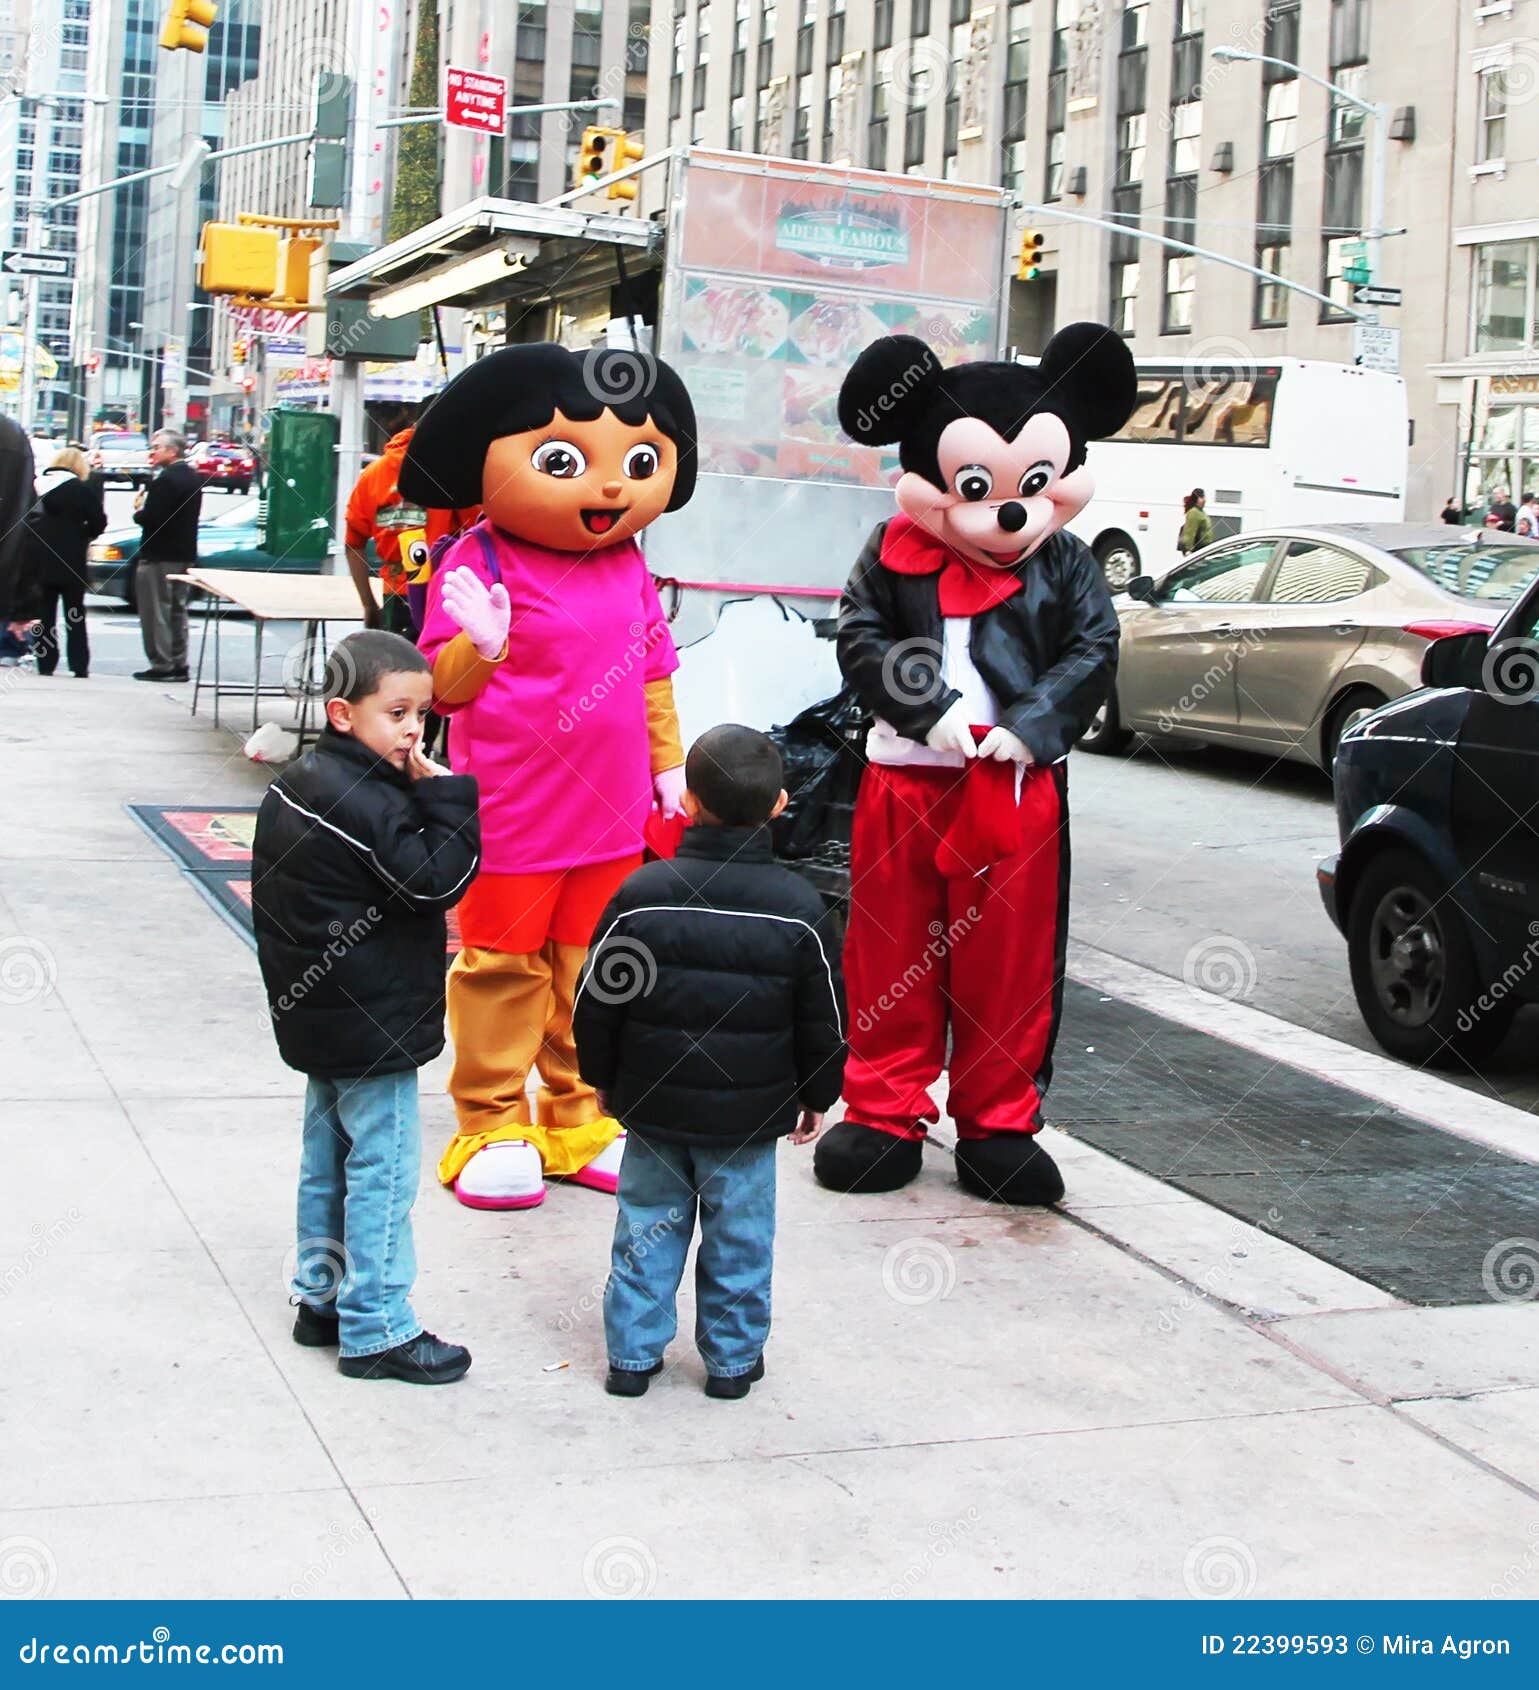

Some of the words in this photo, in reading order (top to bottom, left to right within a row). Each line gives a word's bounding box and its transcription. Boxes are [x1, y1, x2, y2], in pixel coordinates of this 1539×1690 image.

[448, 72, 463, 87] NO
[463, 76, 504, 96] STANDING
[454, 91, 497, 109] ANYTIME
[838, 228, 907, 251] FAMOUS
